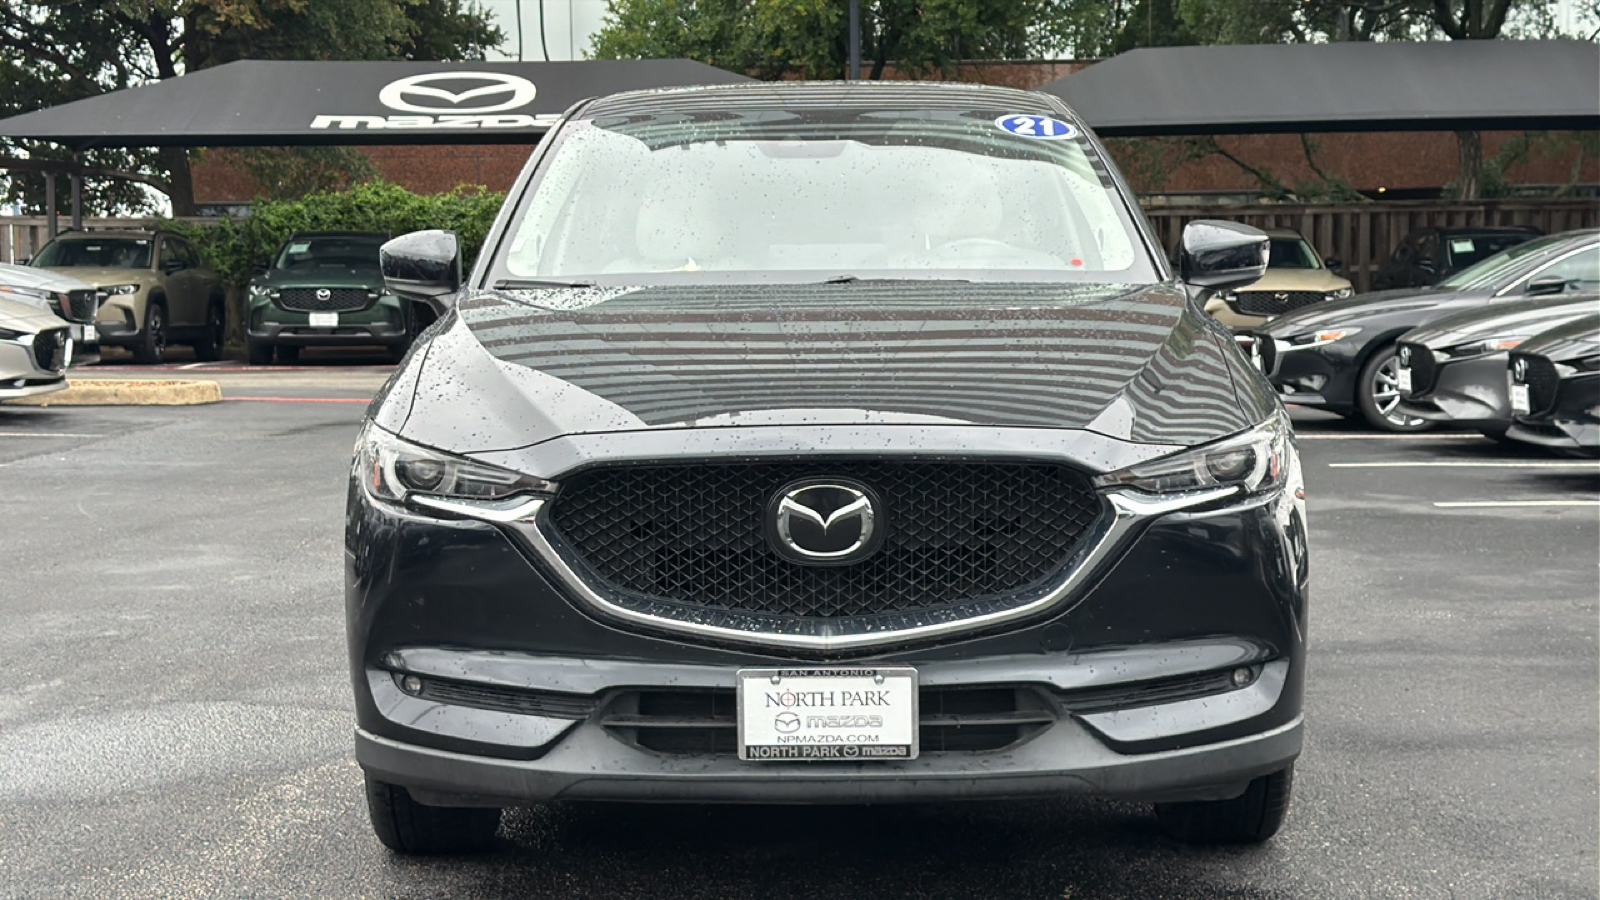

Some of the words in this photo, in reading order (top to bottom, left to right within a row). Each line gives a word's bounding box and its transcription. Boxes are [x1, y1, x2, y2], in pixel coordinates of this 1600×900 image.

[1013, 117, 1054, 136] 21
[765, 690, 835, 708] NORTH
[841, 690, 891, 707] PARK
[806, 715, 883, 728] mazda
[777, 734, 880, 743] NPMAZDA.COM
[749, 746, 798, 758] NORTH
[802, 745, 840, 757] PARK
[862, 746, 907, 756] mazda
